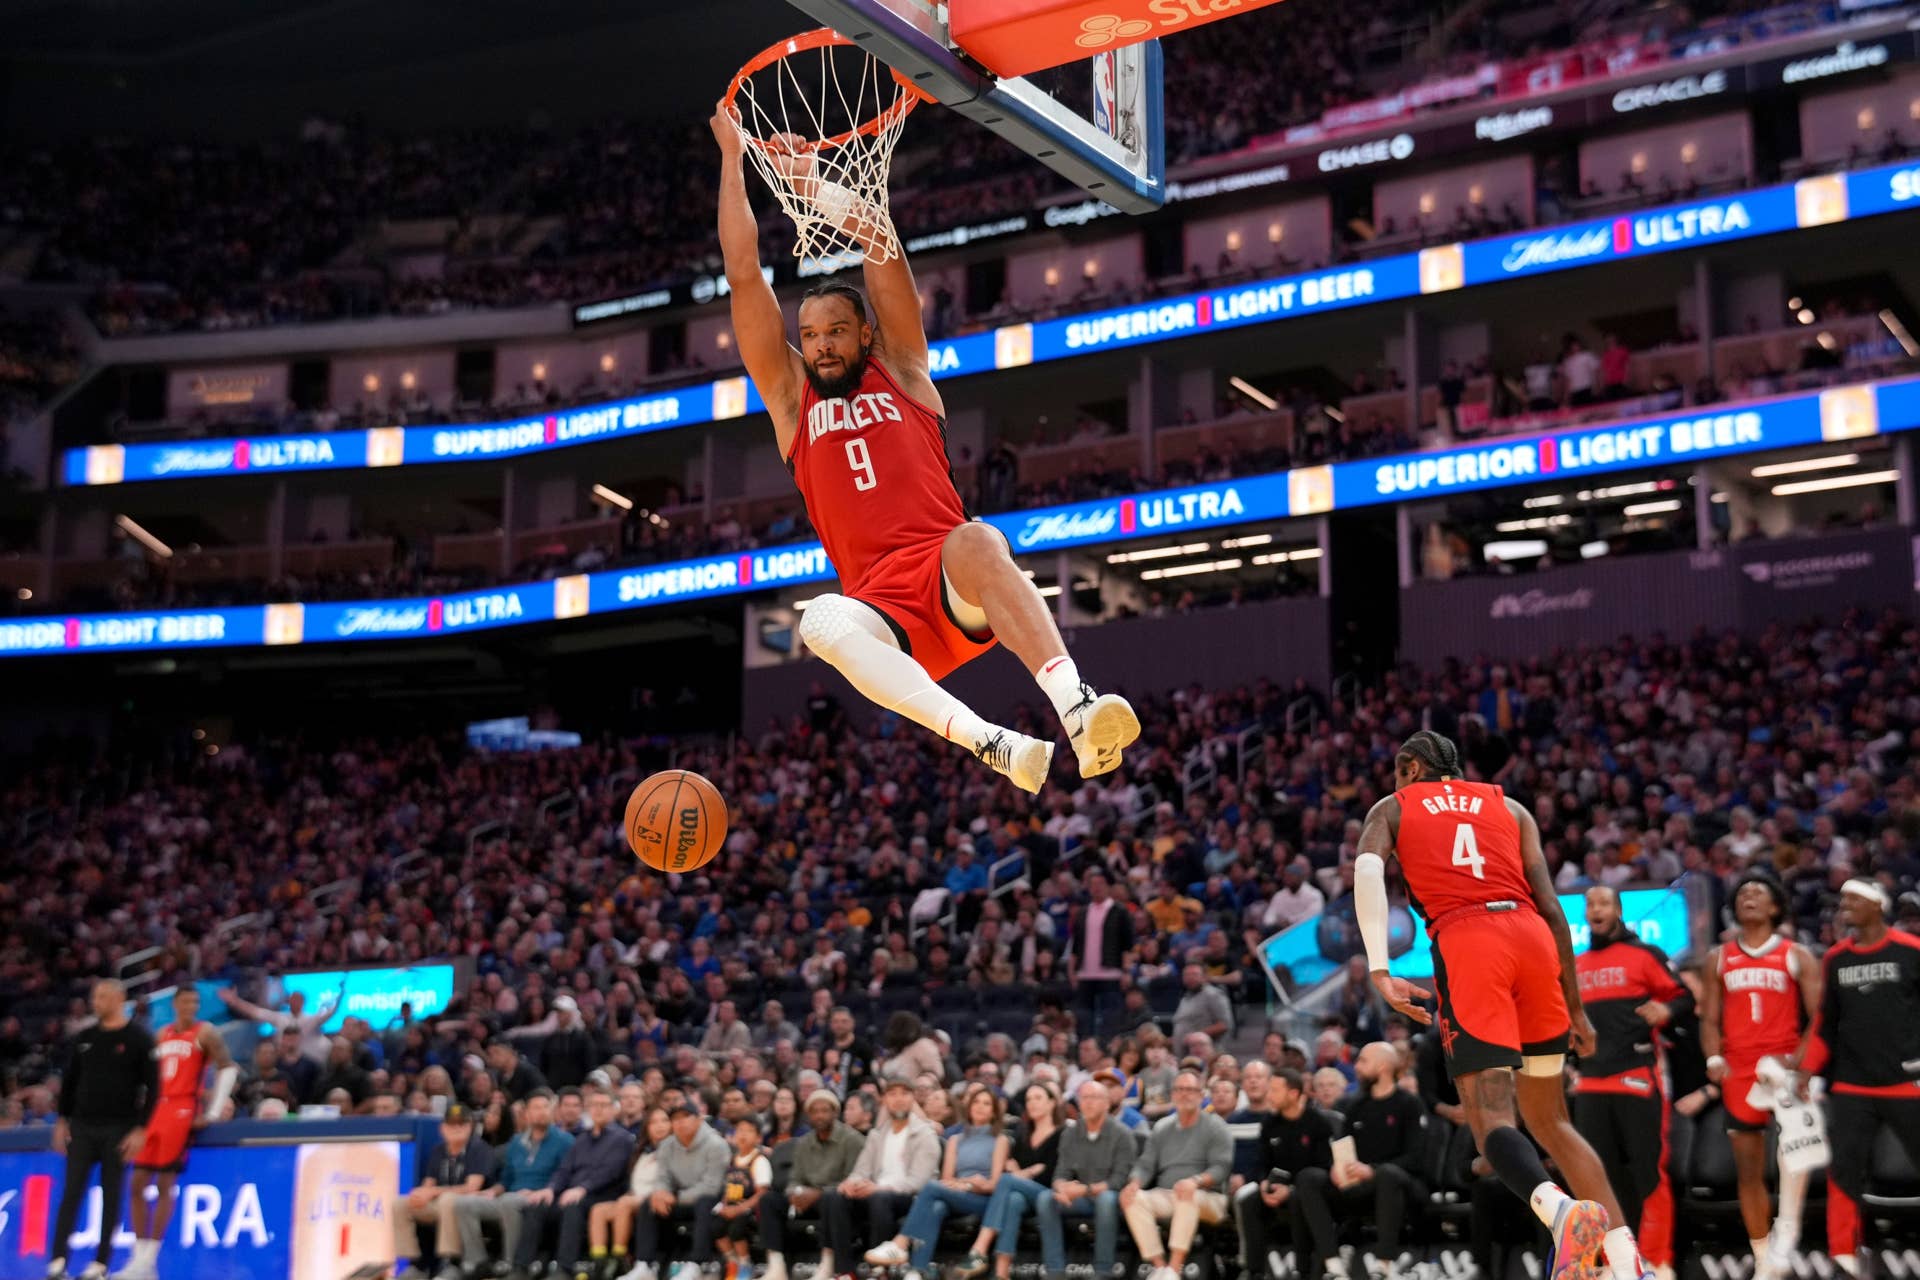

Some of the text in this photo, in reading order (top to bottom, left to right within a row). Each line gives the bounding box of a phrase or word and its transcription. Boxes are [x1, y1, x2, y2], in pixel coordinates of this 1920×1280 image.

[1612, 70, 1727, 112] ORACLE
[1318, 139, 1390, 173] CHASE
[1635, 202, 1751, 246] ULTRA
[1066, 270, 1374, 348] SUPERIOR LIGHT BEER
[929, 346, 960, 370] RA
[433, 397, 679, 455] SUPERIOR LIGHT BEER
[808, 392, 902, 446] ROCKETS
[251, 439, 334, 466] ULTRA
[844, 437, 876, 491] 9
[1376, 412, 1762, 494] SUPERIOR LIGHT BEER
[1140, 488, 1244, 528] ULTRA
[618, 548, 827, 602] SUPERIOR LIGHT
[81, 618, 157, 645] LIGHT
[158, 615, 225, 642] BEER
[443, 593, 523, 627] ULTRA
[1422, 794, 1483, 815] GREEN
[672, 808, 699, 868] Wilson
[1452, 823, 1486, 879] 4
[1723, 967, 1787, 993] ROCKETS
[1838, 961, 1899, 984] ROCKETS
[1749, 992, 1763, 1024] 1
